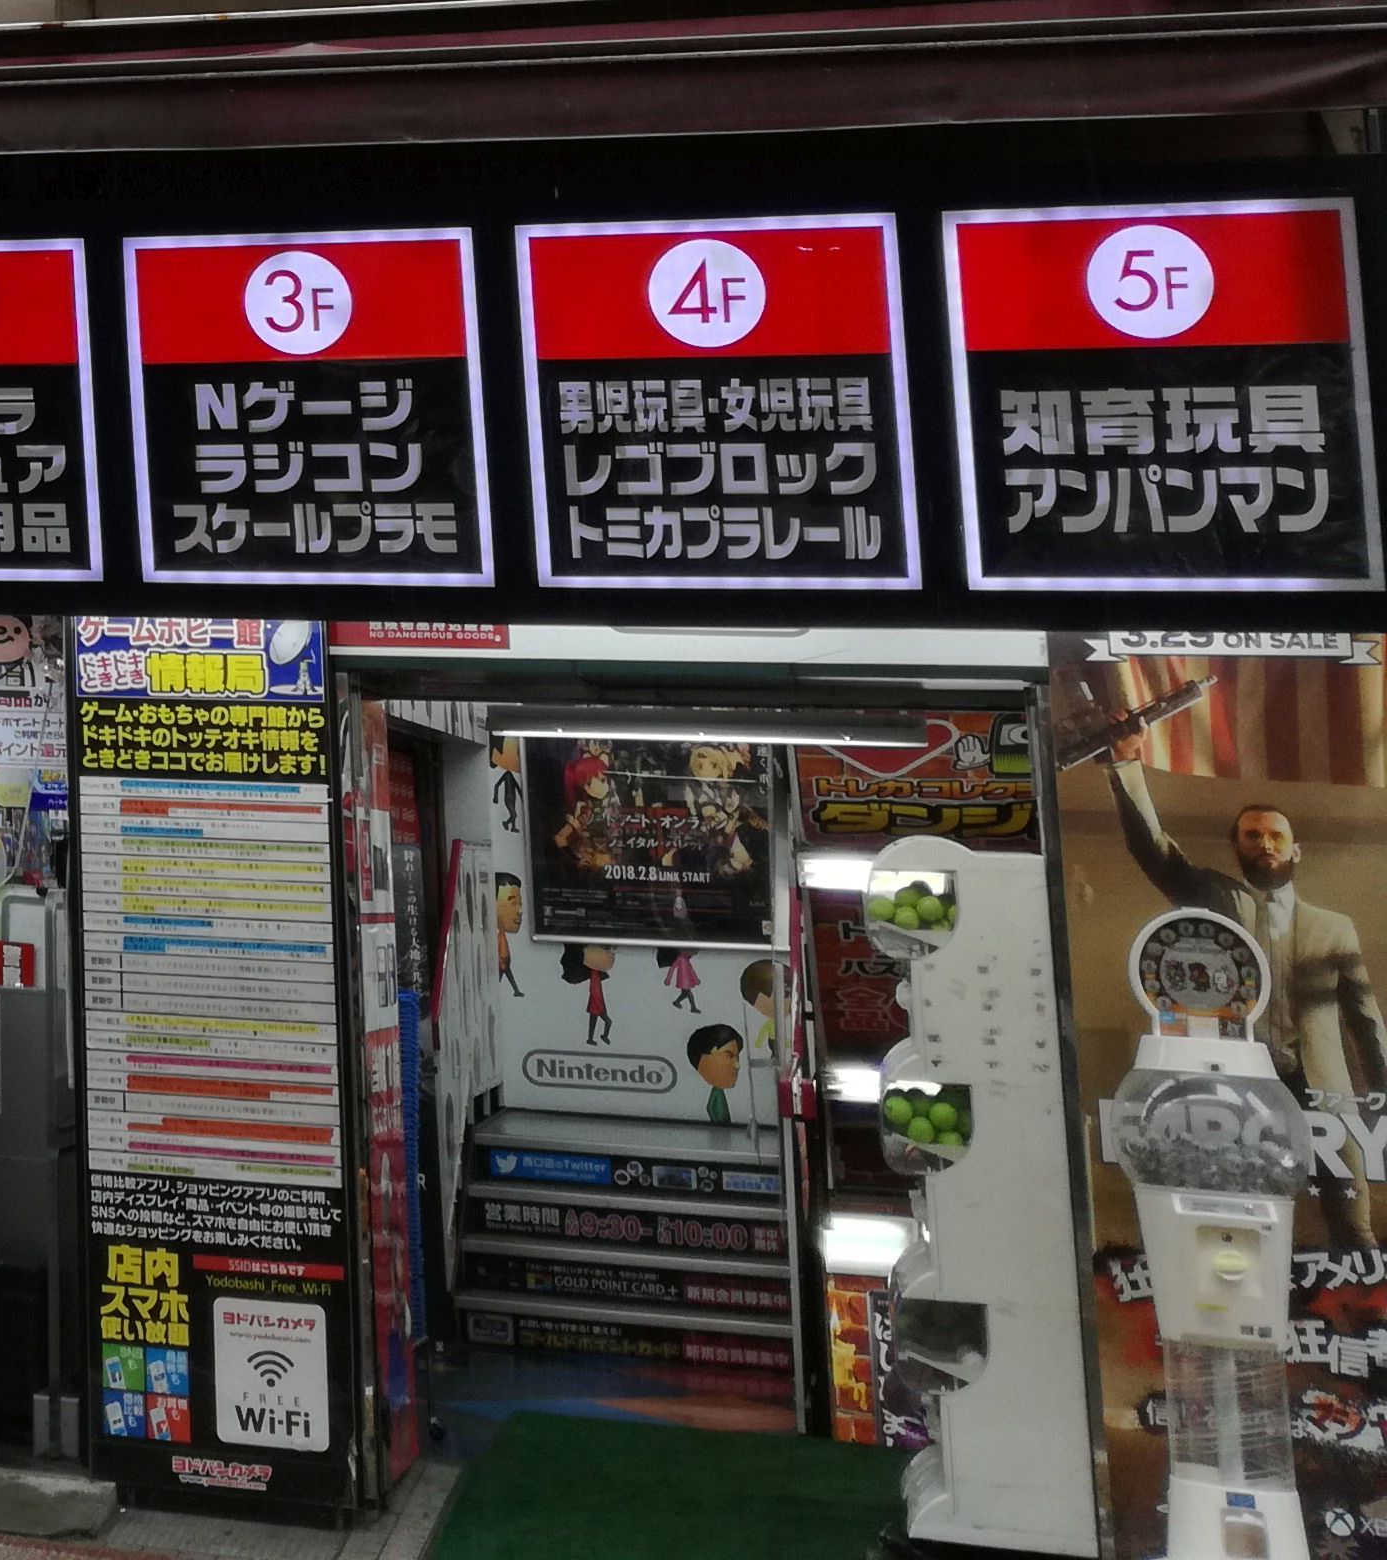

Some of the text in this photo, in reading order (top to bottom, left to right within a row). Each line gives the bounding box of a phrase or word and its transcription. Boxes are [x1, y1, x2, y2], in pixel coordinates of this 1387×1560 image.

[666, 258, 747, 324] 4F
[1115, 249, 1189, 312] 5F
[264, 270, 334, 333] 3F
[194, 378, 414, 432] Nゲージ
[557, 376, 874, 436] 男児玩具・女児玩具
[999, 383, 1326, 457] 知育玩具
[194, 441, 422, 495] ラジコン
[564, 439, 877, 495] レゴブロック
[1001, 467, 1330, 534] アンパンマン
[173, 502, 458, 556] スケールプラモ
[567, 507, 882, 561] トミカプラレール
[369, 630, 384, 638] NO
[388, 631, 453, 640] DANGEROUS
[1222, 633, 1339, 650] ON SALE
[146, 650, 267, 695] 情報局
[81, 702, 325, 729] ゲーム・おもちゃの専門館から
[83, 726, 318, 752] ドキドキのトッテオキ情報を
[604, 865, 711, 883] 2018.2.8 LINK START
[536, 1058, 665, 1086] Nintendo
[484, 1202, 560, 1226] 営業時間
[107, 1244, 180, 1287] 店内
[101, 1285, 189, 1323] スマホ
[554, 1275, 665, 1296] GOLD POINT CARD
[101, 1316, 190, 1346] 使い放題
[222, 1312, 317, 1331] ヨドバシカメラ
[242, 1391, 301, 1408] FREE
[235, 1405, 311, 1438] Wi-Fi
[172, 1456, 273, 1481] ヨドバシカメラ
